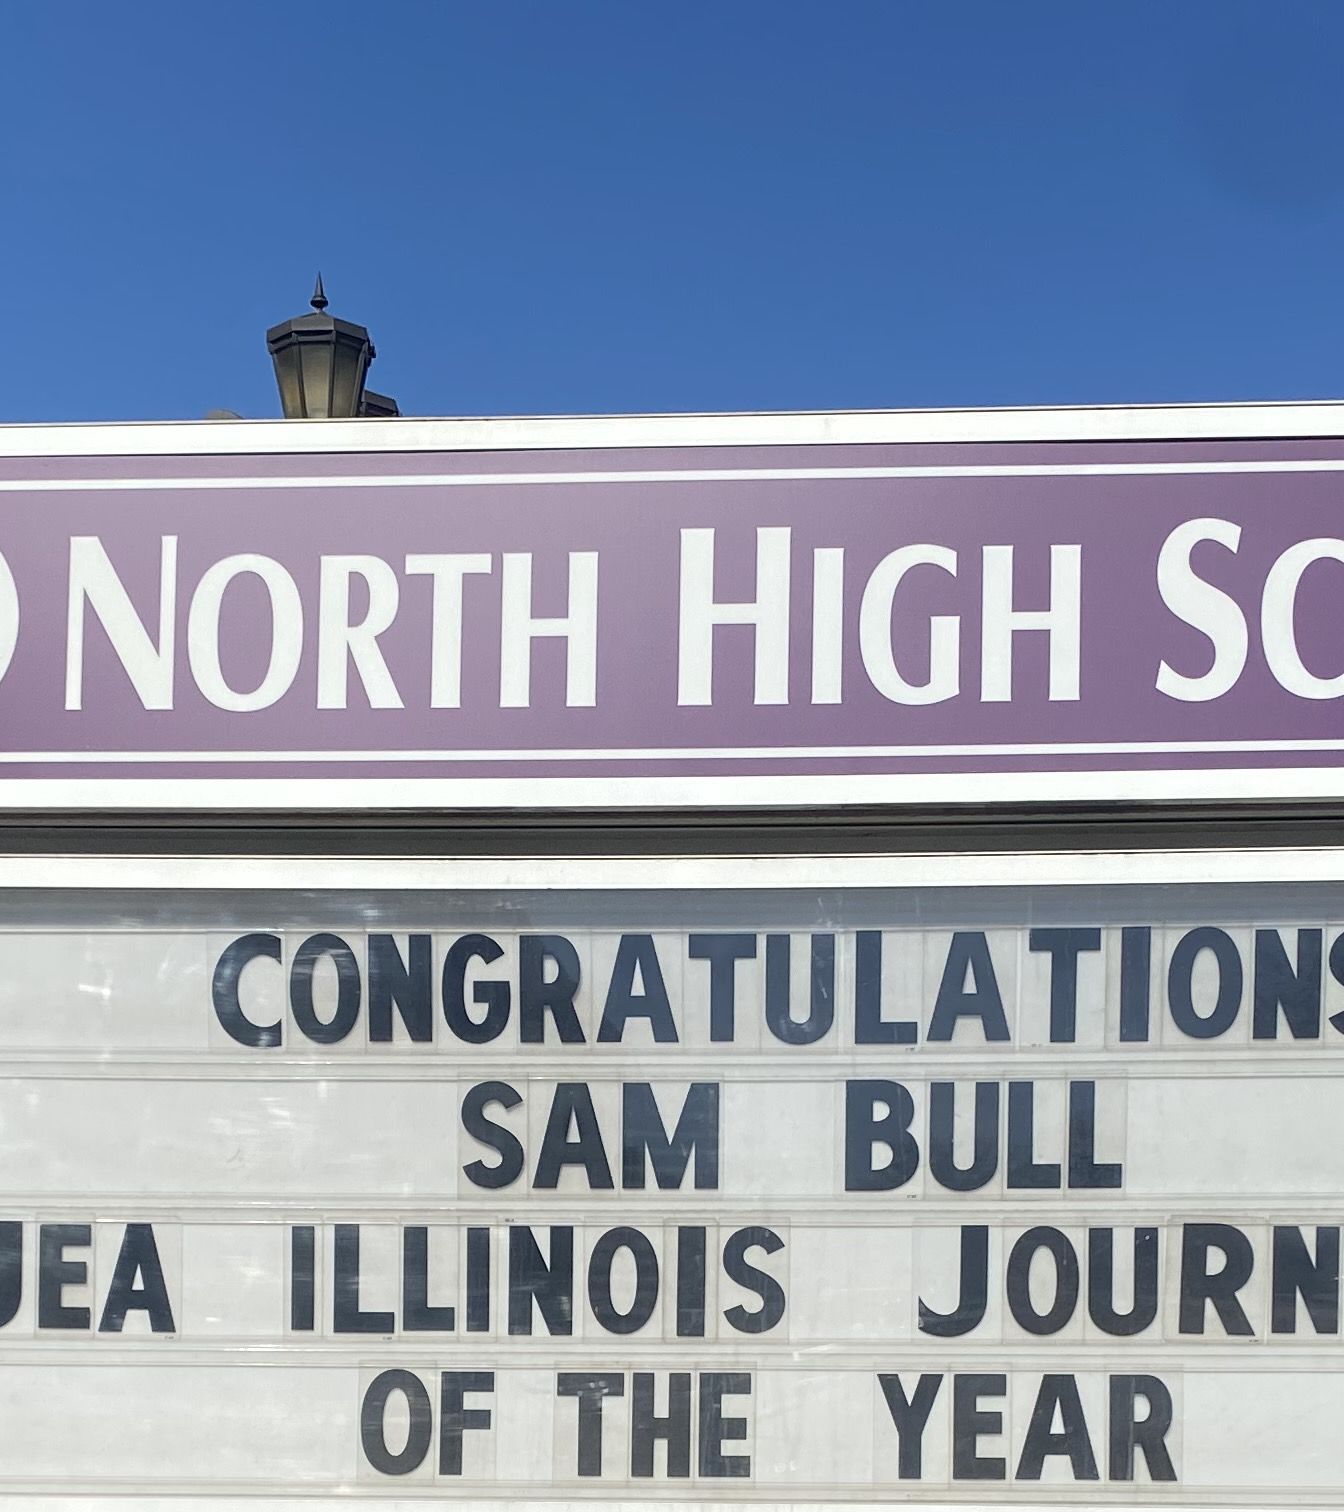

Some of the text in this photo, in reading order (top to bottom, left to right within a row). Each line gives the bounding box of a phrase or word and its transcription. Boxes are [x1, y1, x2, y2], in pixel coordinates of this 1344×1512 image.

[461, 1079, 1123, 1192] SAM BULL
[291, 1223, 786, 1337] ILLINOIS
[361, 1368, 1178, 1482] OF THE YEAR
